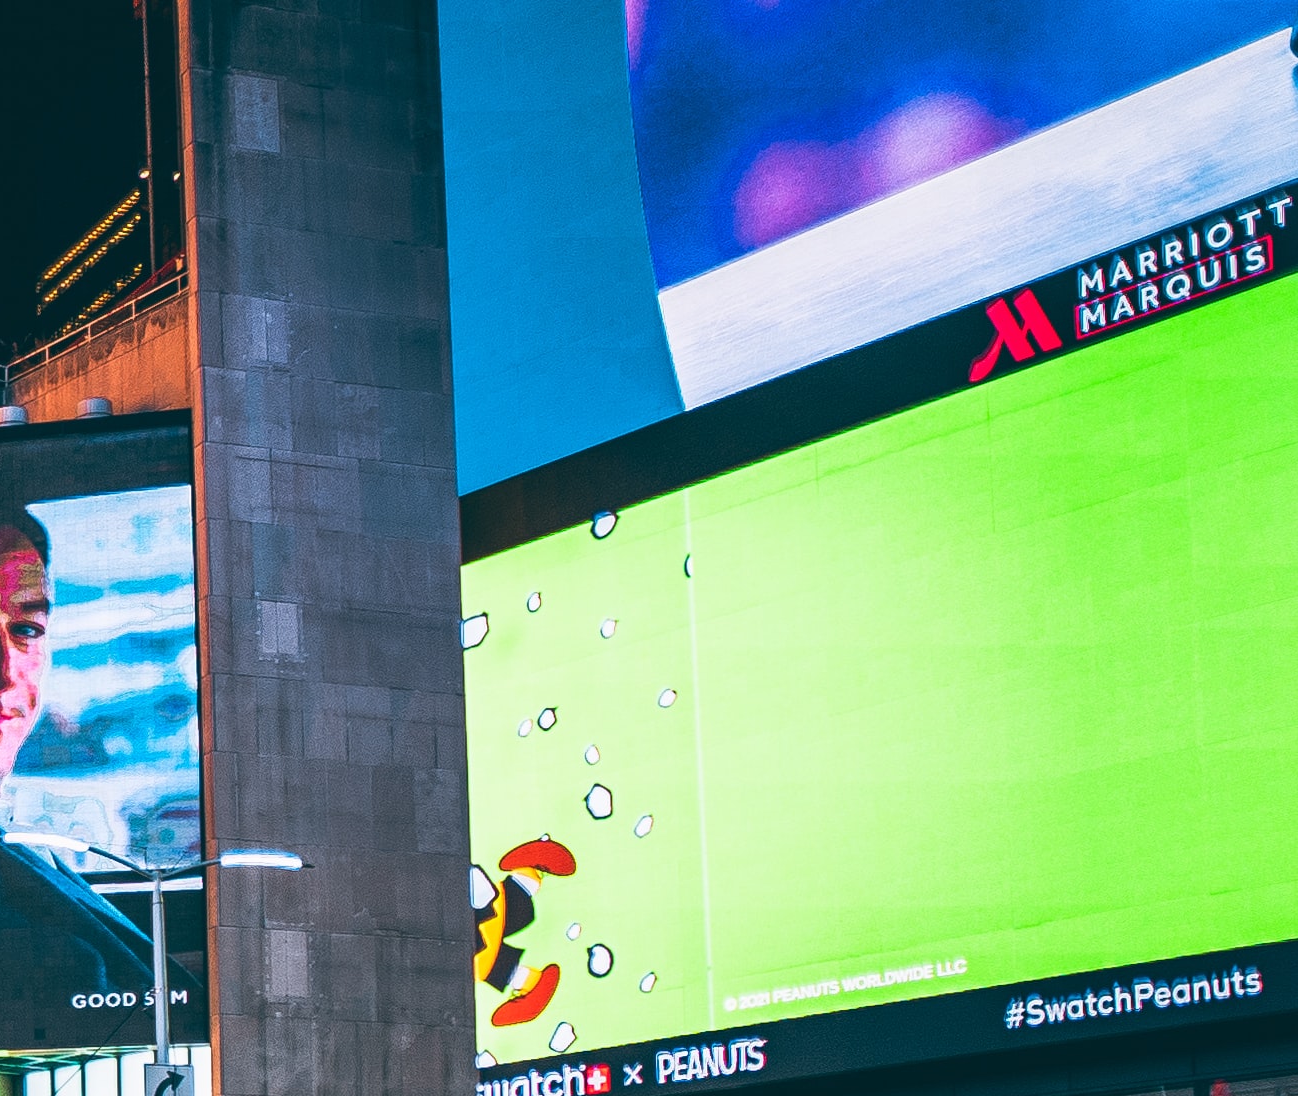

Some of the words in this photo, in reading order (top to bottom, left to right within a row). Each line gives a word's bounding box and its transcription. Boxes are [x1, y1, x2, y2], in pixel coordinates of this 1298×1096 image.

[1077, 192, 1293, 299] MARRIOTT
[1079, 245, 1266, 333] MARQUIS
[71, 992, 138, 1010] GOOD
[143, 989, 189, 1007] SM
[738, 990, 770, 1010] 2021
[772, 980, 840, 1006] PEANUTS
[841, 967, 934, 996] WORLDWIDE
[935, 956, 968, 977] LLC
[1006, 968, 1263, 1031] #SwatchPeanuts
[657, 1038, 767, 1085] PEANUTS
